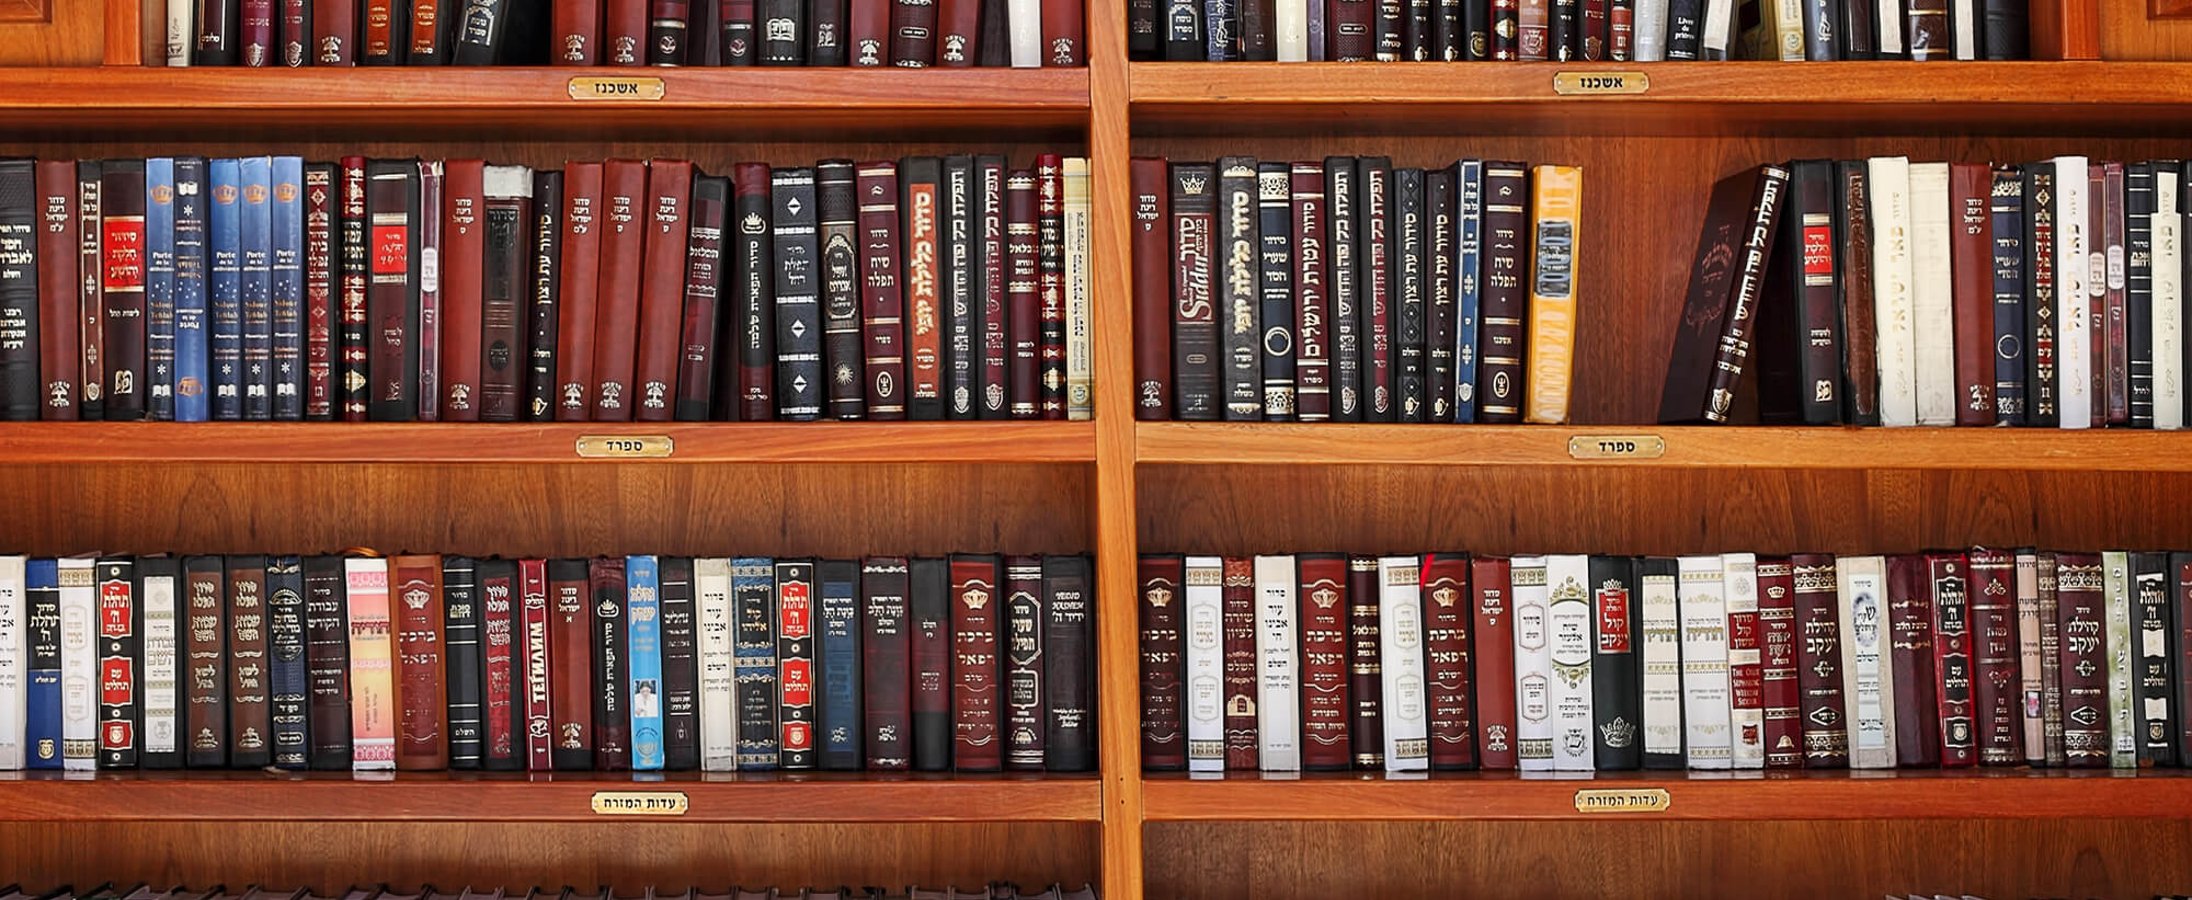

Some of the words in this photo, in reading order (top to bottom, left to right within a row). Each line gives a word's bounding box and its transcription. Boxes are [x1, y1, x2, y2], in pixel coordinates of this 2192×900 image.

[1581, 77, 1623, 88] אשכנז
[595, 83, 638, 94] אשכנז
[1179, 253, 1212, 320] Siddur
[606, 440, 643, 451] ספרד
[1599, 441, 1635, 453] ספרד
[2069, 637, 2099, 655] יעקב
[604, 798, 642, 808] המזרח
[647, 797, 676, 809] עדות
[1587, 796, 1625, 807] המזרח
[1629, 794, 1658, 806] עדות
